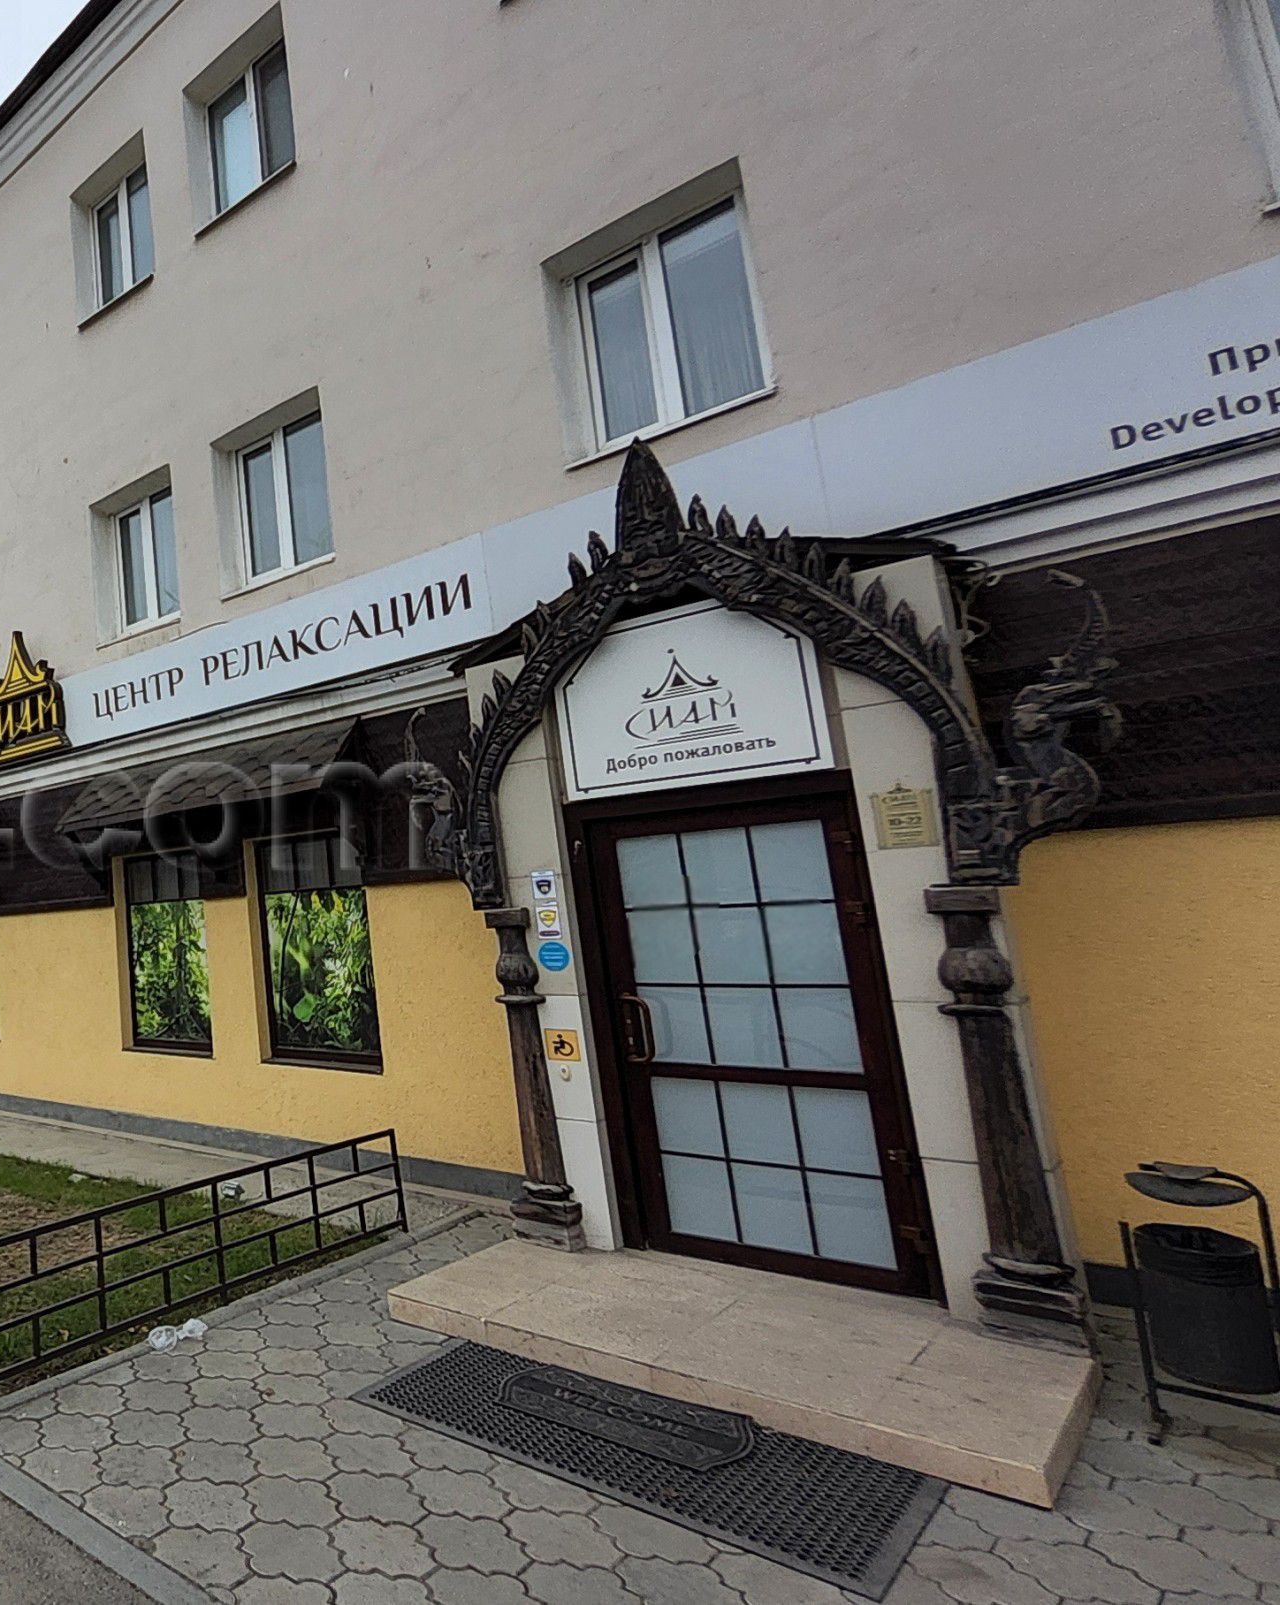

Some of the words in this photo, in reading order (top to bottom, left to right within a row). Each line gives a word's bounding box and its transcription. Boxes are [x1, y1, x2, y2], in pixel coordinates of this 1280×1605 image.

[1208, 338, 1280, 376] Пр
[93, 667, 184, 720] ЦЕНТР
[200, 574, 472, 685] РЕЛАКСАЦИИ
[606, 753, 658, 774] Добро
[663, 737, 776, 764] пожаловать
[553, 1387, 690, 1436] WELCOME
